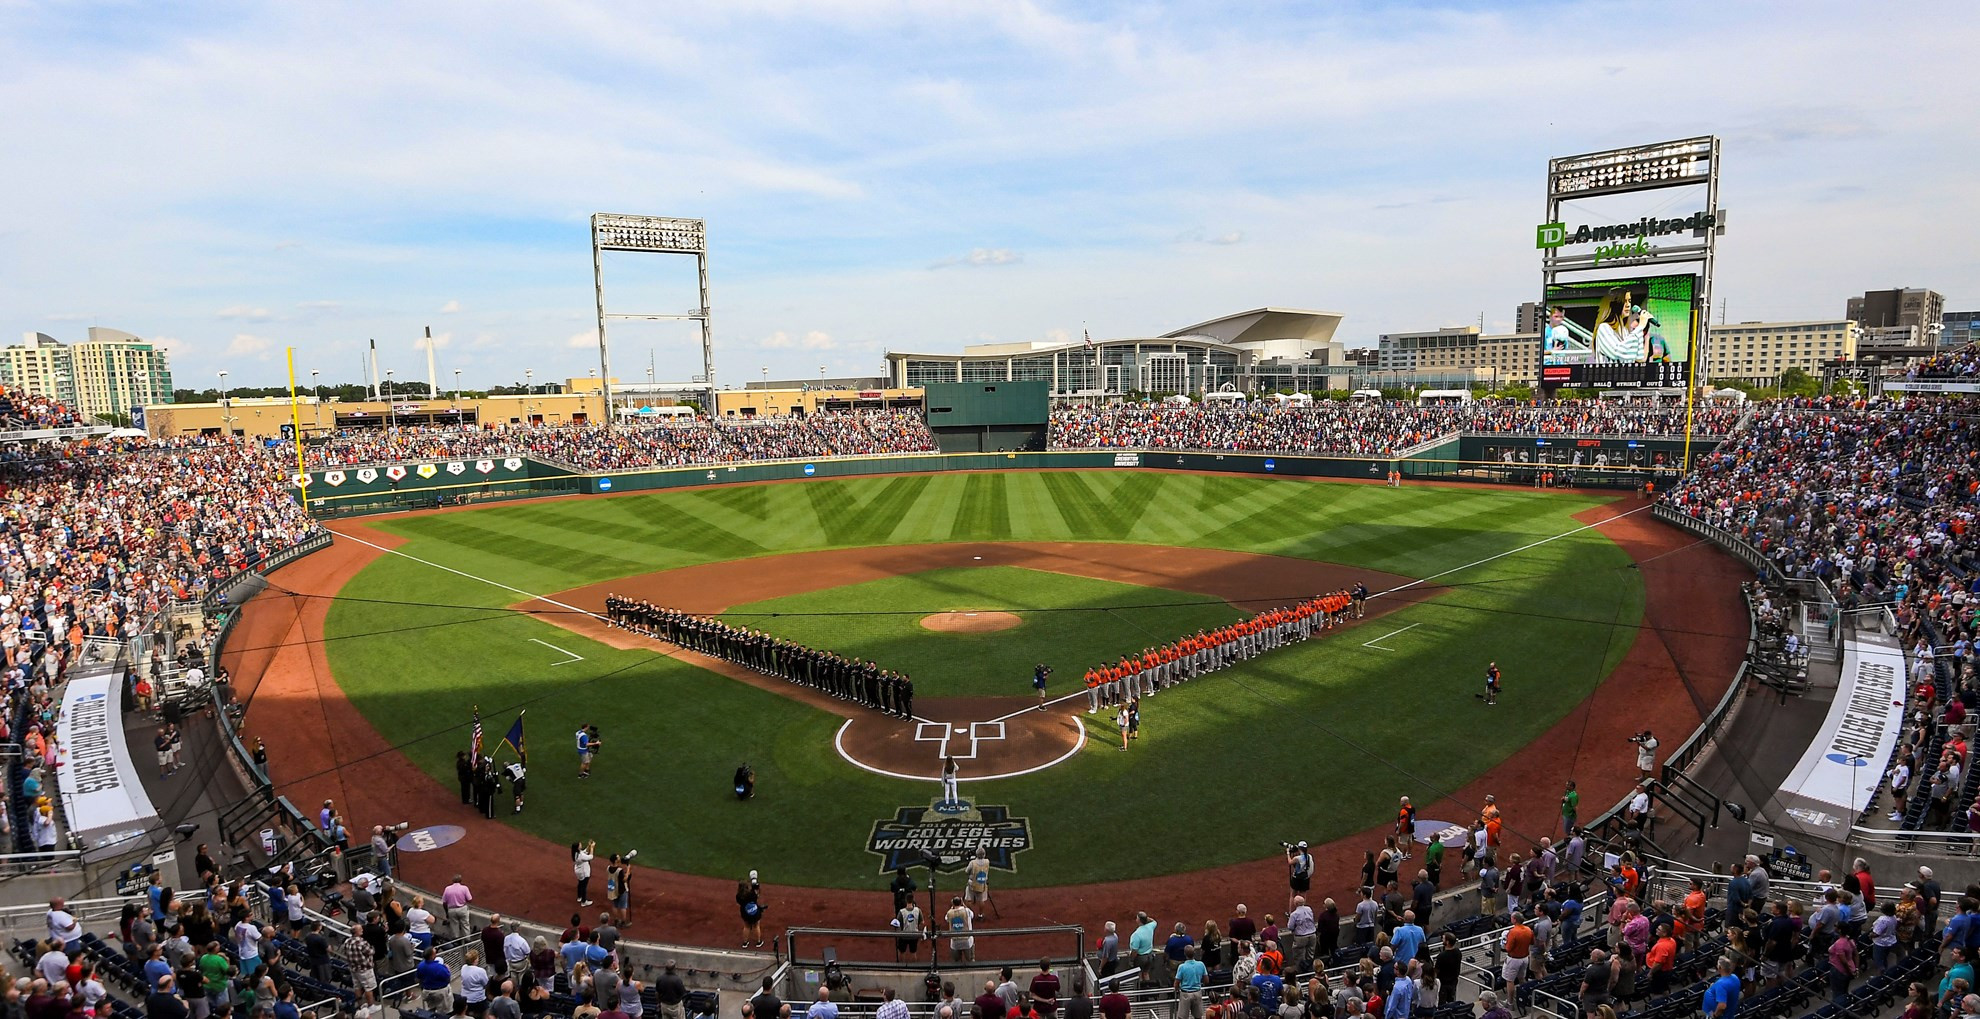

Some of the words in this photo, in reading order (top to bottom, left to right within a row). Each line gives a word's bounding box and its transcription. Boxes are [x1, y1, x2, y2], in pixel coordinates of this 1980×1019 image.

[1540, 228, 1562, 243] TD
[1574, 212, 1716, 242] Ameritrade
[1594, 233, 1648, 265] park
[1857, 661, 1894, 690] SERIES
[71, 700, 106, 731] COLLEGE
[1847, 685, 1892, 718] WORLD
[71, 728, 111, 760] WORLD
[1831, 713, 1886, 759] COLLEGE
[73, 757, 120, 794] SERIES
[410, 830, 437, 851] NCAA
[874, 838, 949, 849] WORLD
[950, 837, 1026, 848] SERIES
[906, 828, 995, 838] COLLEGE
[1775, 860, 1801, 870] COLLEGE
[1788, 868, 1810, 879] SERIES
[118, 884, 139, 894] WORLD
